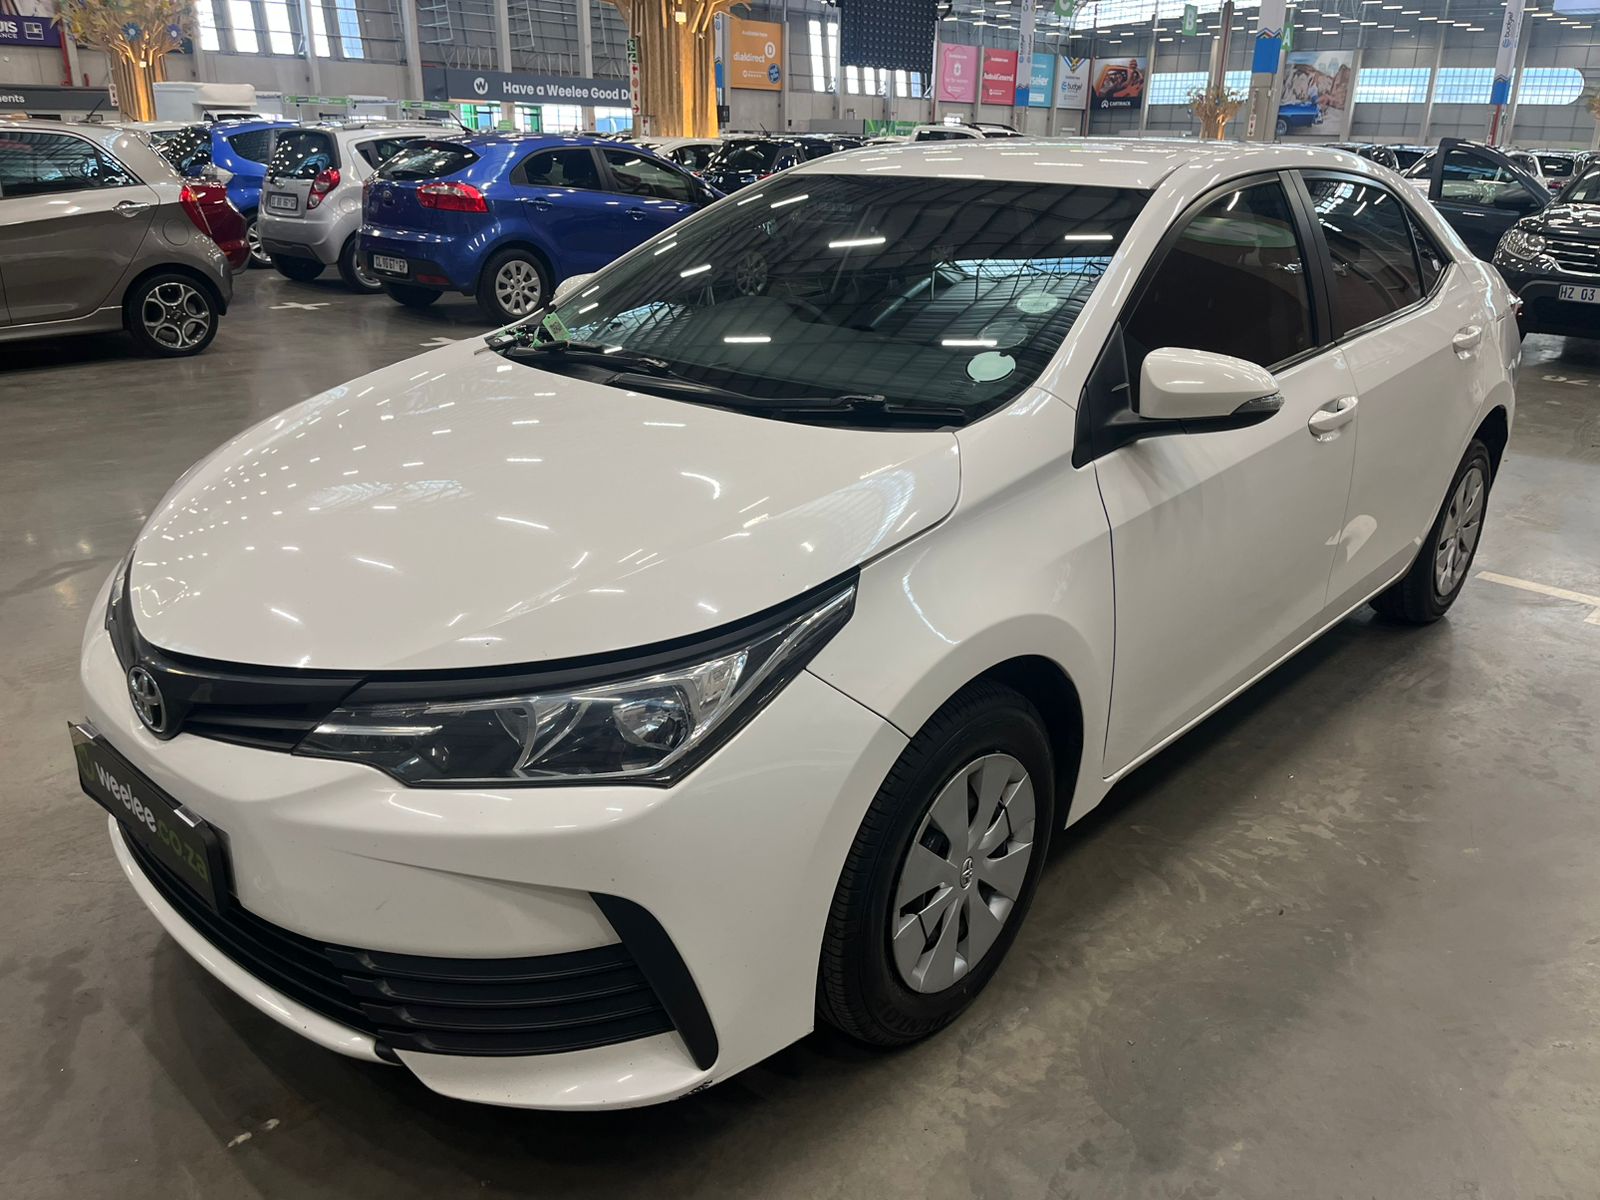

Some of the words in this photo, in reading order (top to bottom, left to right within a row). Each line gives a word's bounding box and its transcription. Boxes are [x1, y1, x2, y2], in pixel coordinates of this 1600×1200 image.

[1185, 11, 1194, 30] B
[1283, 27, 1291, 46] A
[503, 82, 534, 95] Have
[536, 87, 544, 95] a
[546, 84, 588, 98] Weelee
[591, 87, 620, 100] Good
[621, 89, 632, 100] Da
[1560, 285, 1575, 299] HZ
[1581, 288, 1595, 301] 03
